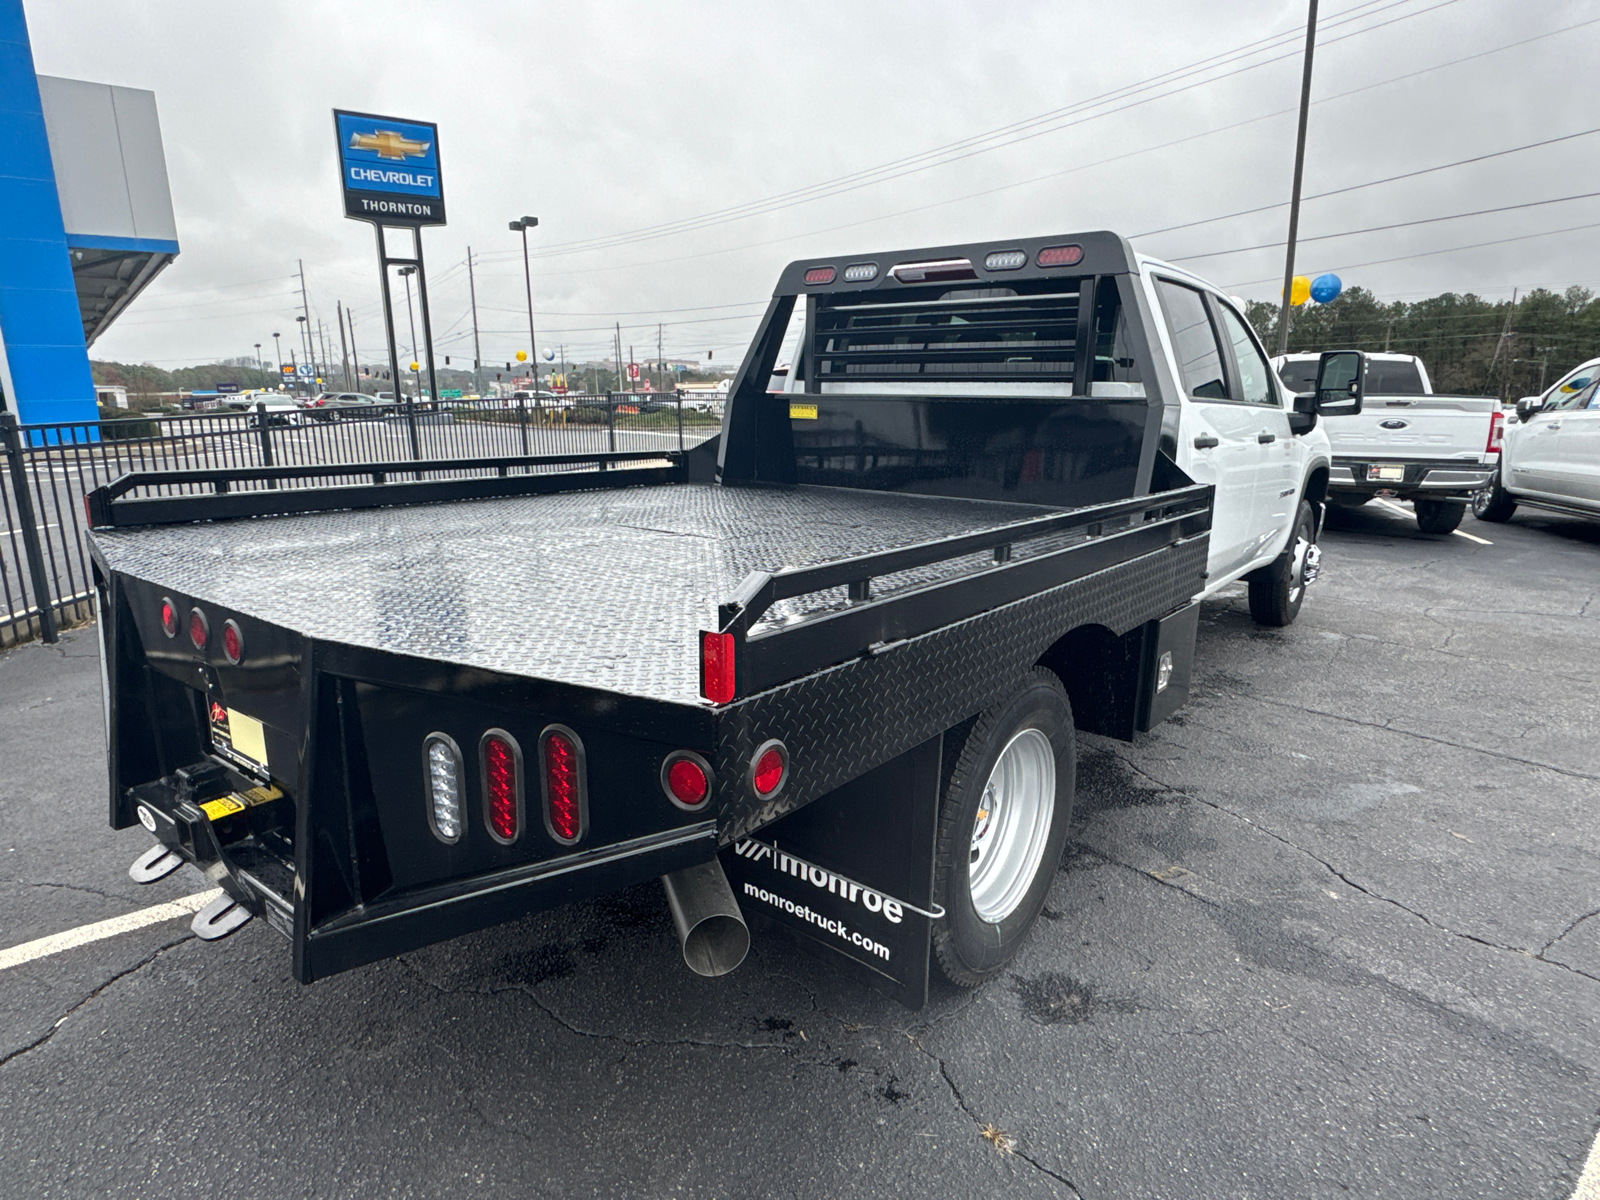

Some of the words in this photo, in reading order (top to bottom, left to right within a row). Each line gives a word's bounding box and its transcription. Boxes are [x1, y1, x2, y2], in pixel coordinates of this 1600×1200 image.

[351, 168, 433, 187] CHEVROLET
[362, 200, 431, 215] THORNTON
[780, 852, 904, 924] monroe
[743, 882, 890, 961] monroetruck.com
